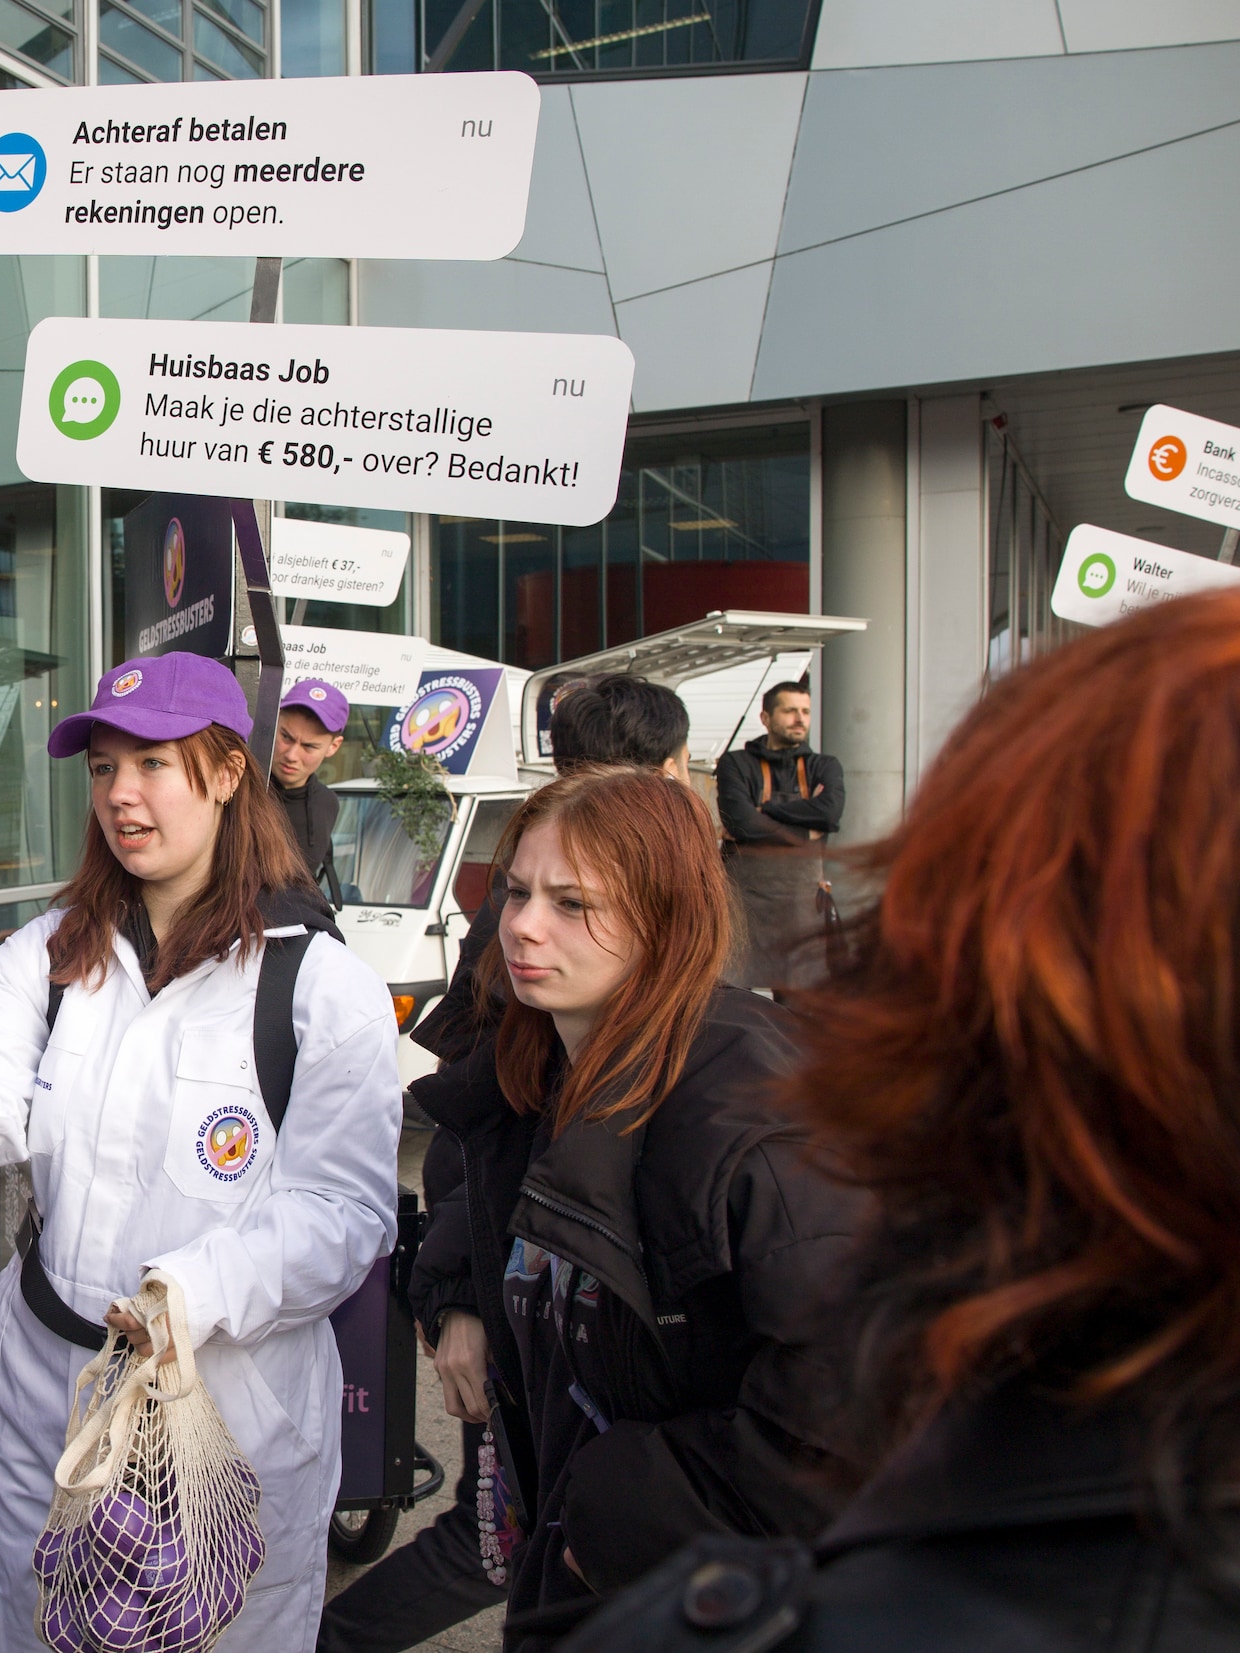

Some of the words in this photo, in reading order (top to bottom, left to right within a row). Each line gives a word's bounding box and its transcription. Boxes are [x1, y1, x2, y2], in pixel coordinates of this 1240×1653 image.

[72, 116, 183, 145] Achteraf
[188, 115, 288, 143] betalen
[461, 119, 493, 138] nu
[69, 160, 95, 185] Er
[100, 161, 169, 184] staan
[177, 164, 226, 190] nog
[233, 155, 365, 183] meerdere
[64, 199, 205, 231] rekeningen
[212, 205, 284, 231] open.
[148, 352, 271, 382] Huisbaas
[277, 358, 330, 385] Job
[552, 378, 586, 398] nu
[144, 392, 215, 420] Maak
[220, 397, 245, 428] je
[252, 397, 292, 425] die
[300, 401, 493, 443] achterstallige
[139, 431, 198, 459] huur
[204, 441, 249, 463] van
[257, 441, 275, 465] €
[282, 441, 353, 475] 580,-
[362, 451, 439, 477] over?
[447, 452, 580, 488] Bedankt!
[1203, 440, 1236, 462] Bank
[277, 552, 329, 570] alsjeblieft
[332, 559, 339, 570] €
[340, 560, 361, 574] 37,-
[381, 548, 393, 558] nu
[1133, 556, 1174, 580] Walter
[290, 572, 335, 588] drankjes
[337, 577, 384, 593] gisteren?
[1127, 578, 1147, 596] Wil
[1146, 584, 1160, 601] je
[138, 593, 215, 654] GELDSTRESSBUSTERS
[306, 643, 327, 654] Job
[400, 653, 412, 662] nu
[294, 658, 310, 670] die
[312, 660, 380, 678] achterstallige
[333, 680, 360, 691] over?
[362, 681, 405, 694] Bedankt!
[197, 1105, 259, 1145] GELDSTRESSBUSTERS
[196, 1141, 258, 1182] GELDSTRESSBUSTERS
